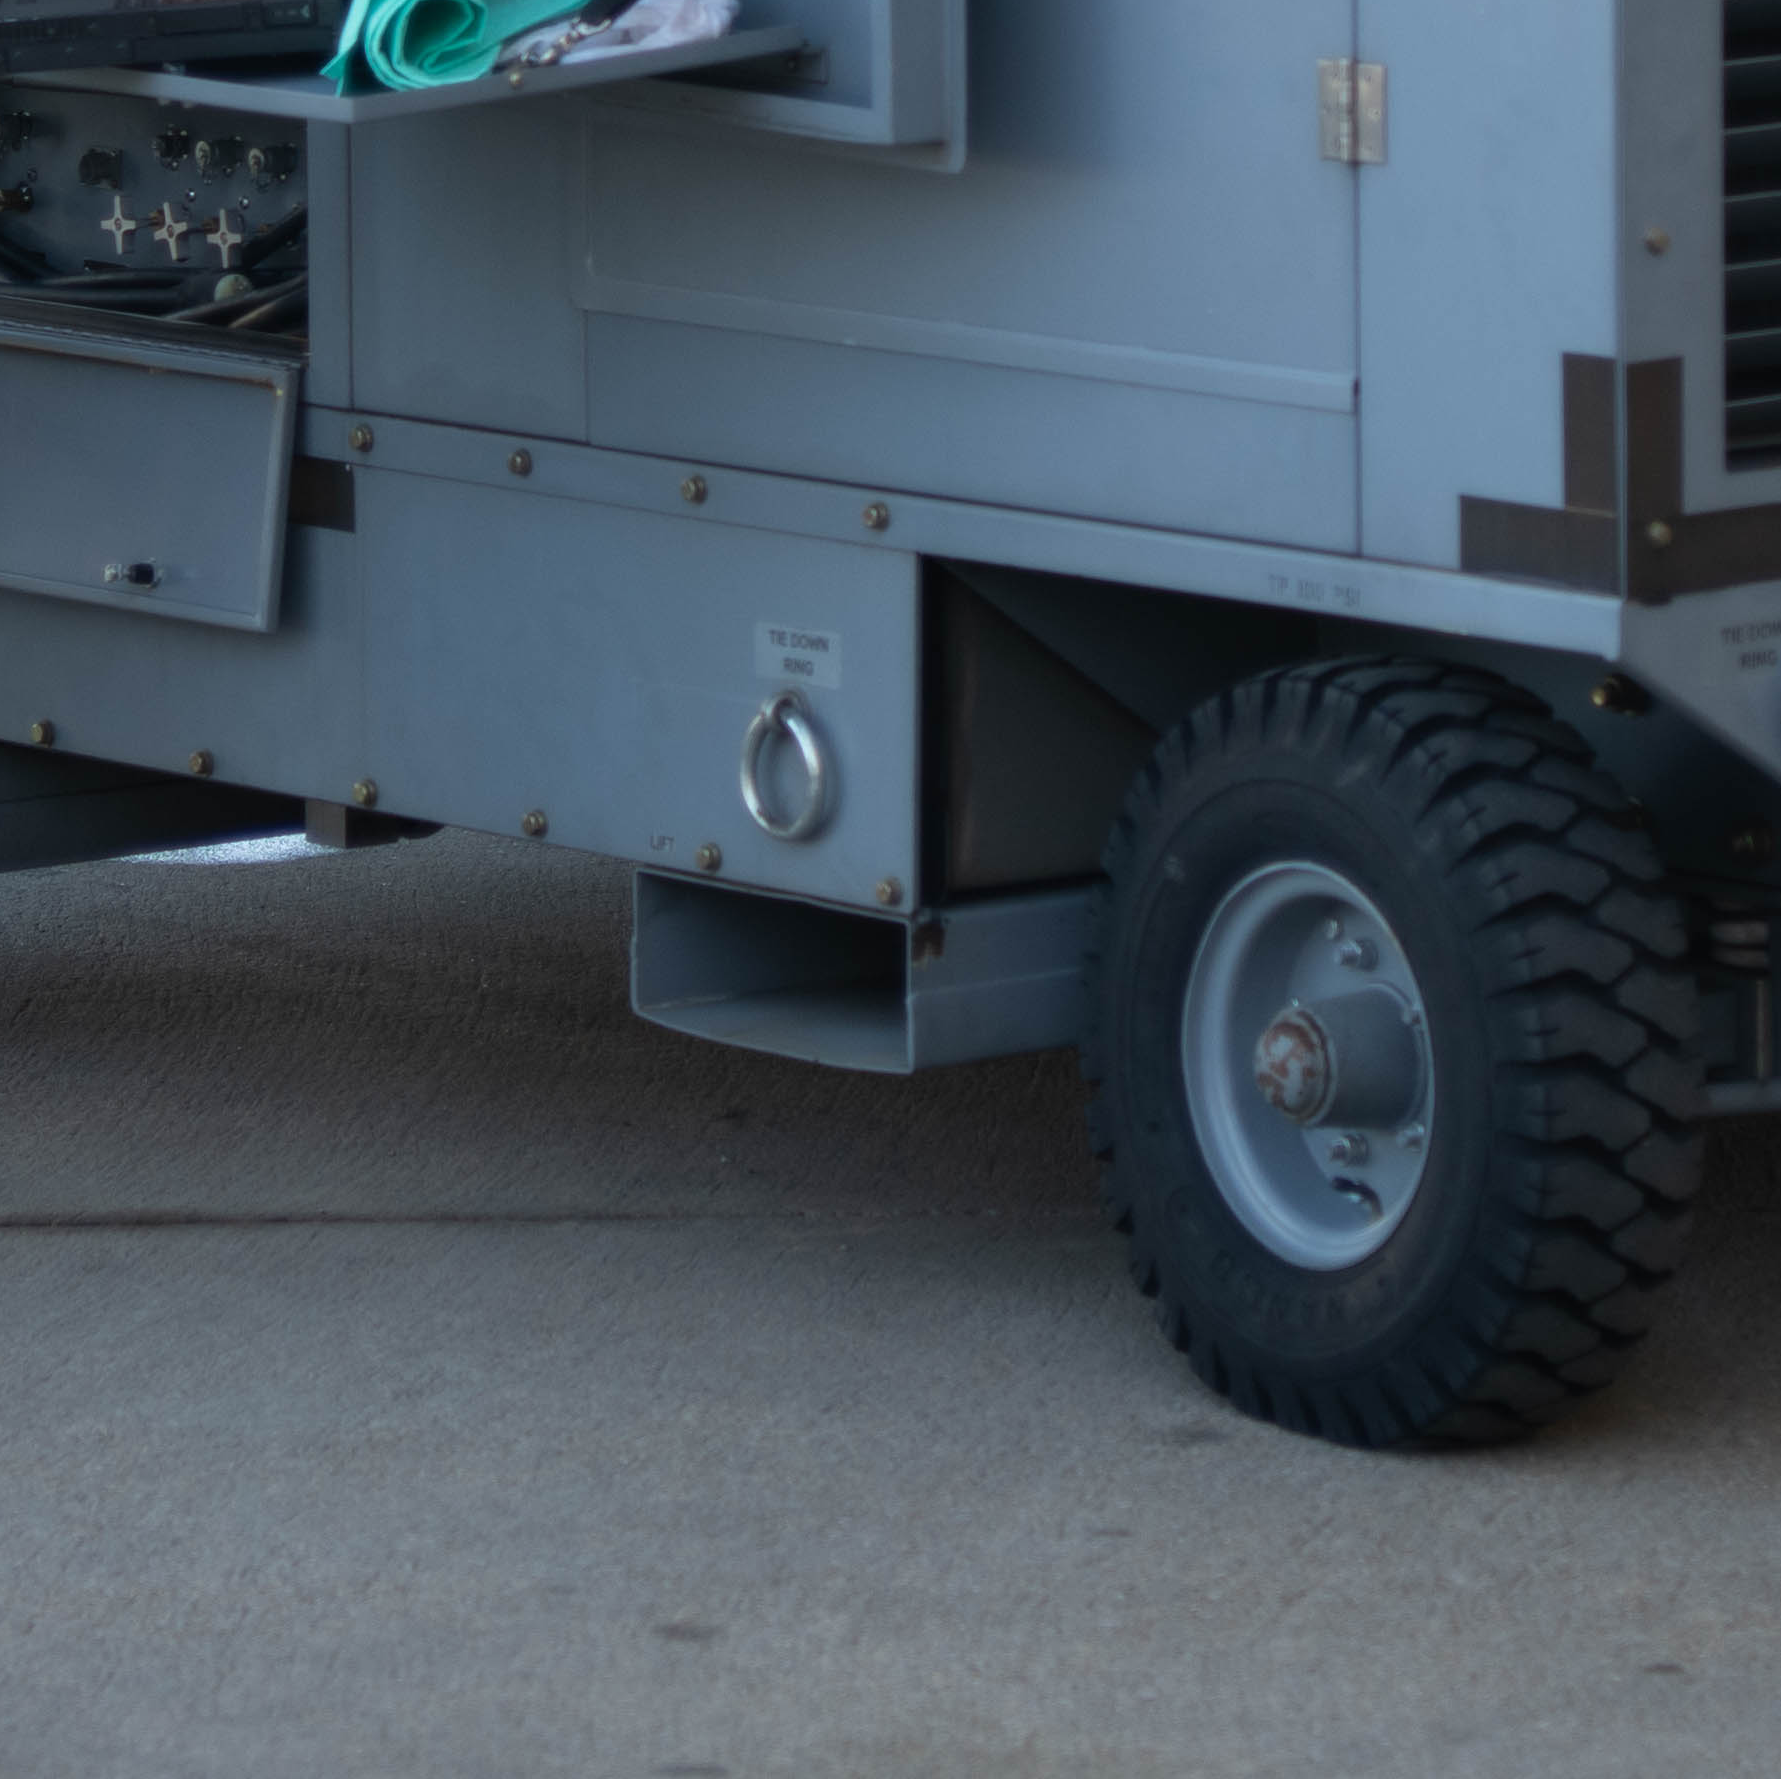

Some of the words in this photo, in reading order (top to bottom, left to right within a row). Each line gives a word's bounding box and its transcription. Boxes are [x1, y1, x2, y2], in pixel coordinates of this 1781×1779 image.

[769, 629, 788, 648] TIE
[790, 632, 829, 652] DOWN
[783, 657, 814, 677] RING
